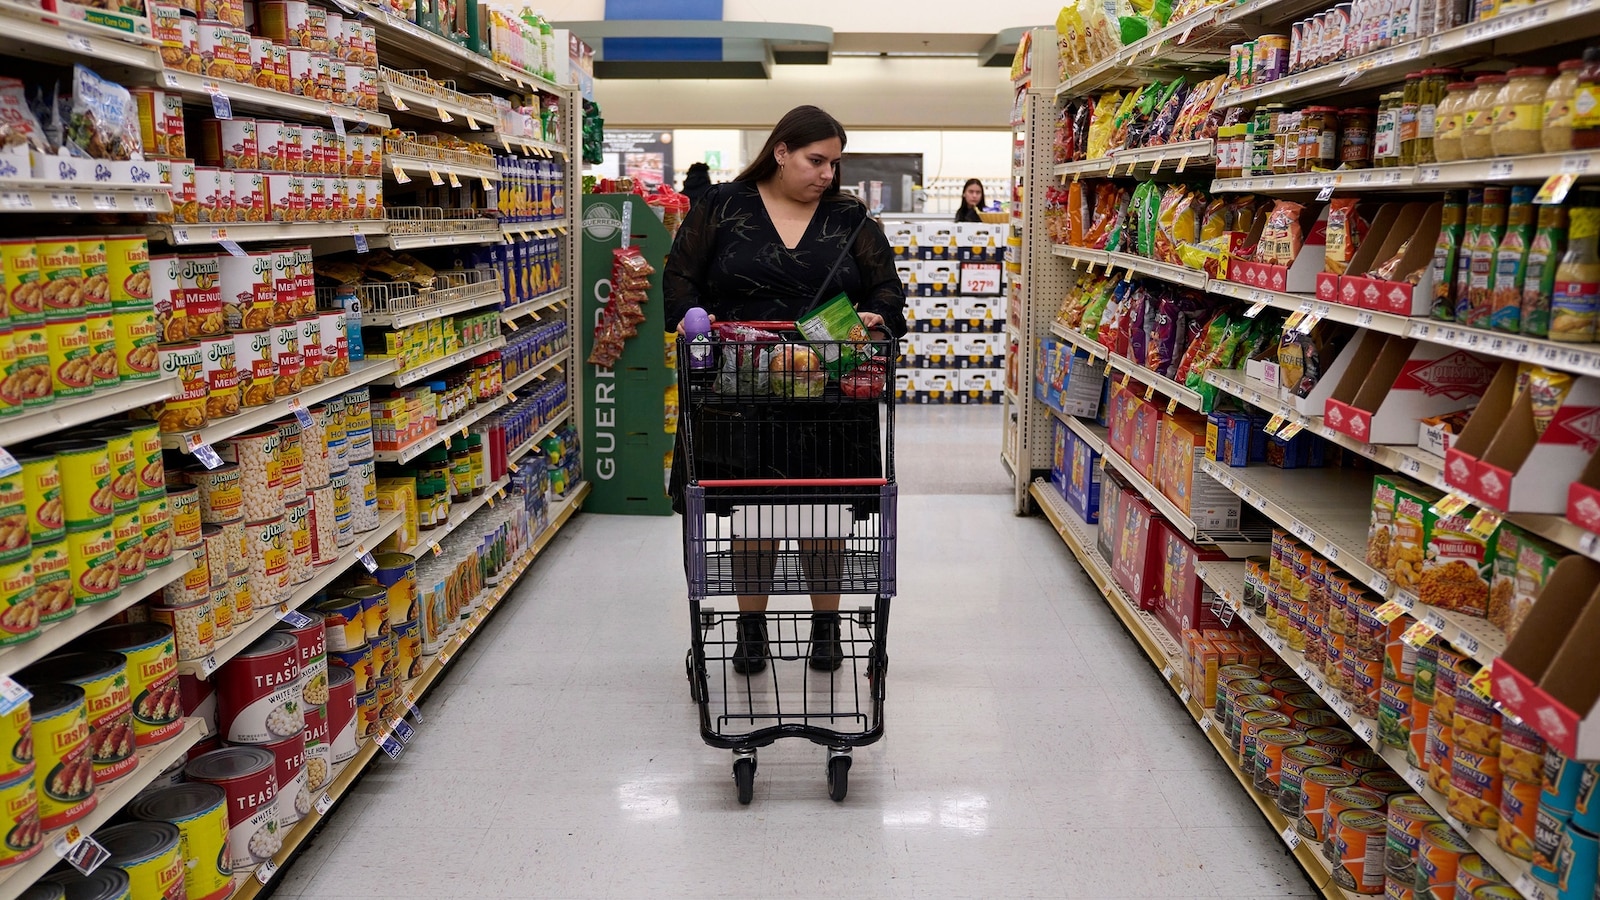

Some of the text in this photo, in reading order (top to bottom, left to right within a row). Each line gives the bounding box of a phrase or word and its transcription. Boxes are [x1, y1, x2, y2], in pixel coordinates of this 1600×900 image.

[583, 219, 621, 227] GUERRERO
[351, 303, 360, 312] G
[1428, 365, 1490, 383] LOUISIANA
[1427, 428, 1442, 440] Andy's
[1439, 543, 1477, 554] JAMBALAYA
[269, 689, 291, 704] WHITE
[251, 809, 272, 825] WHITE
